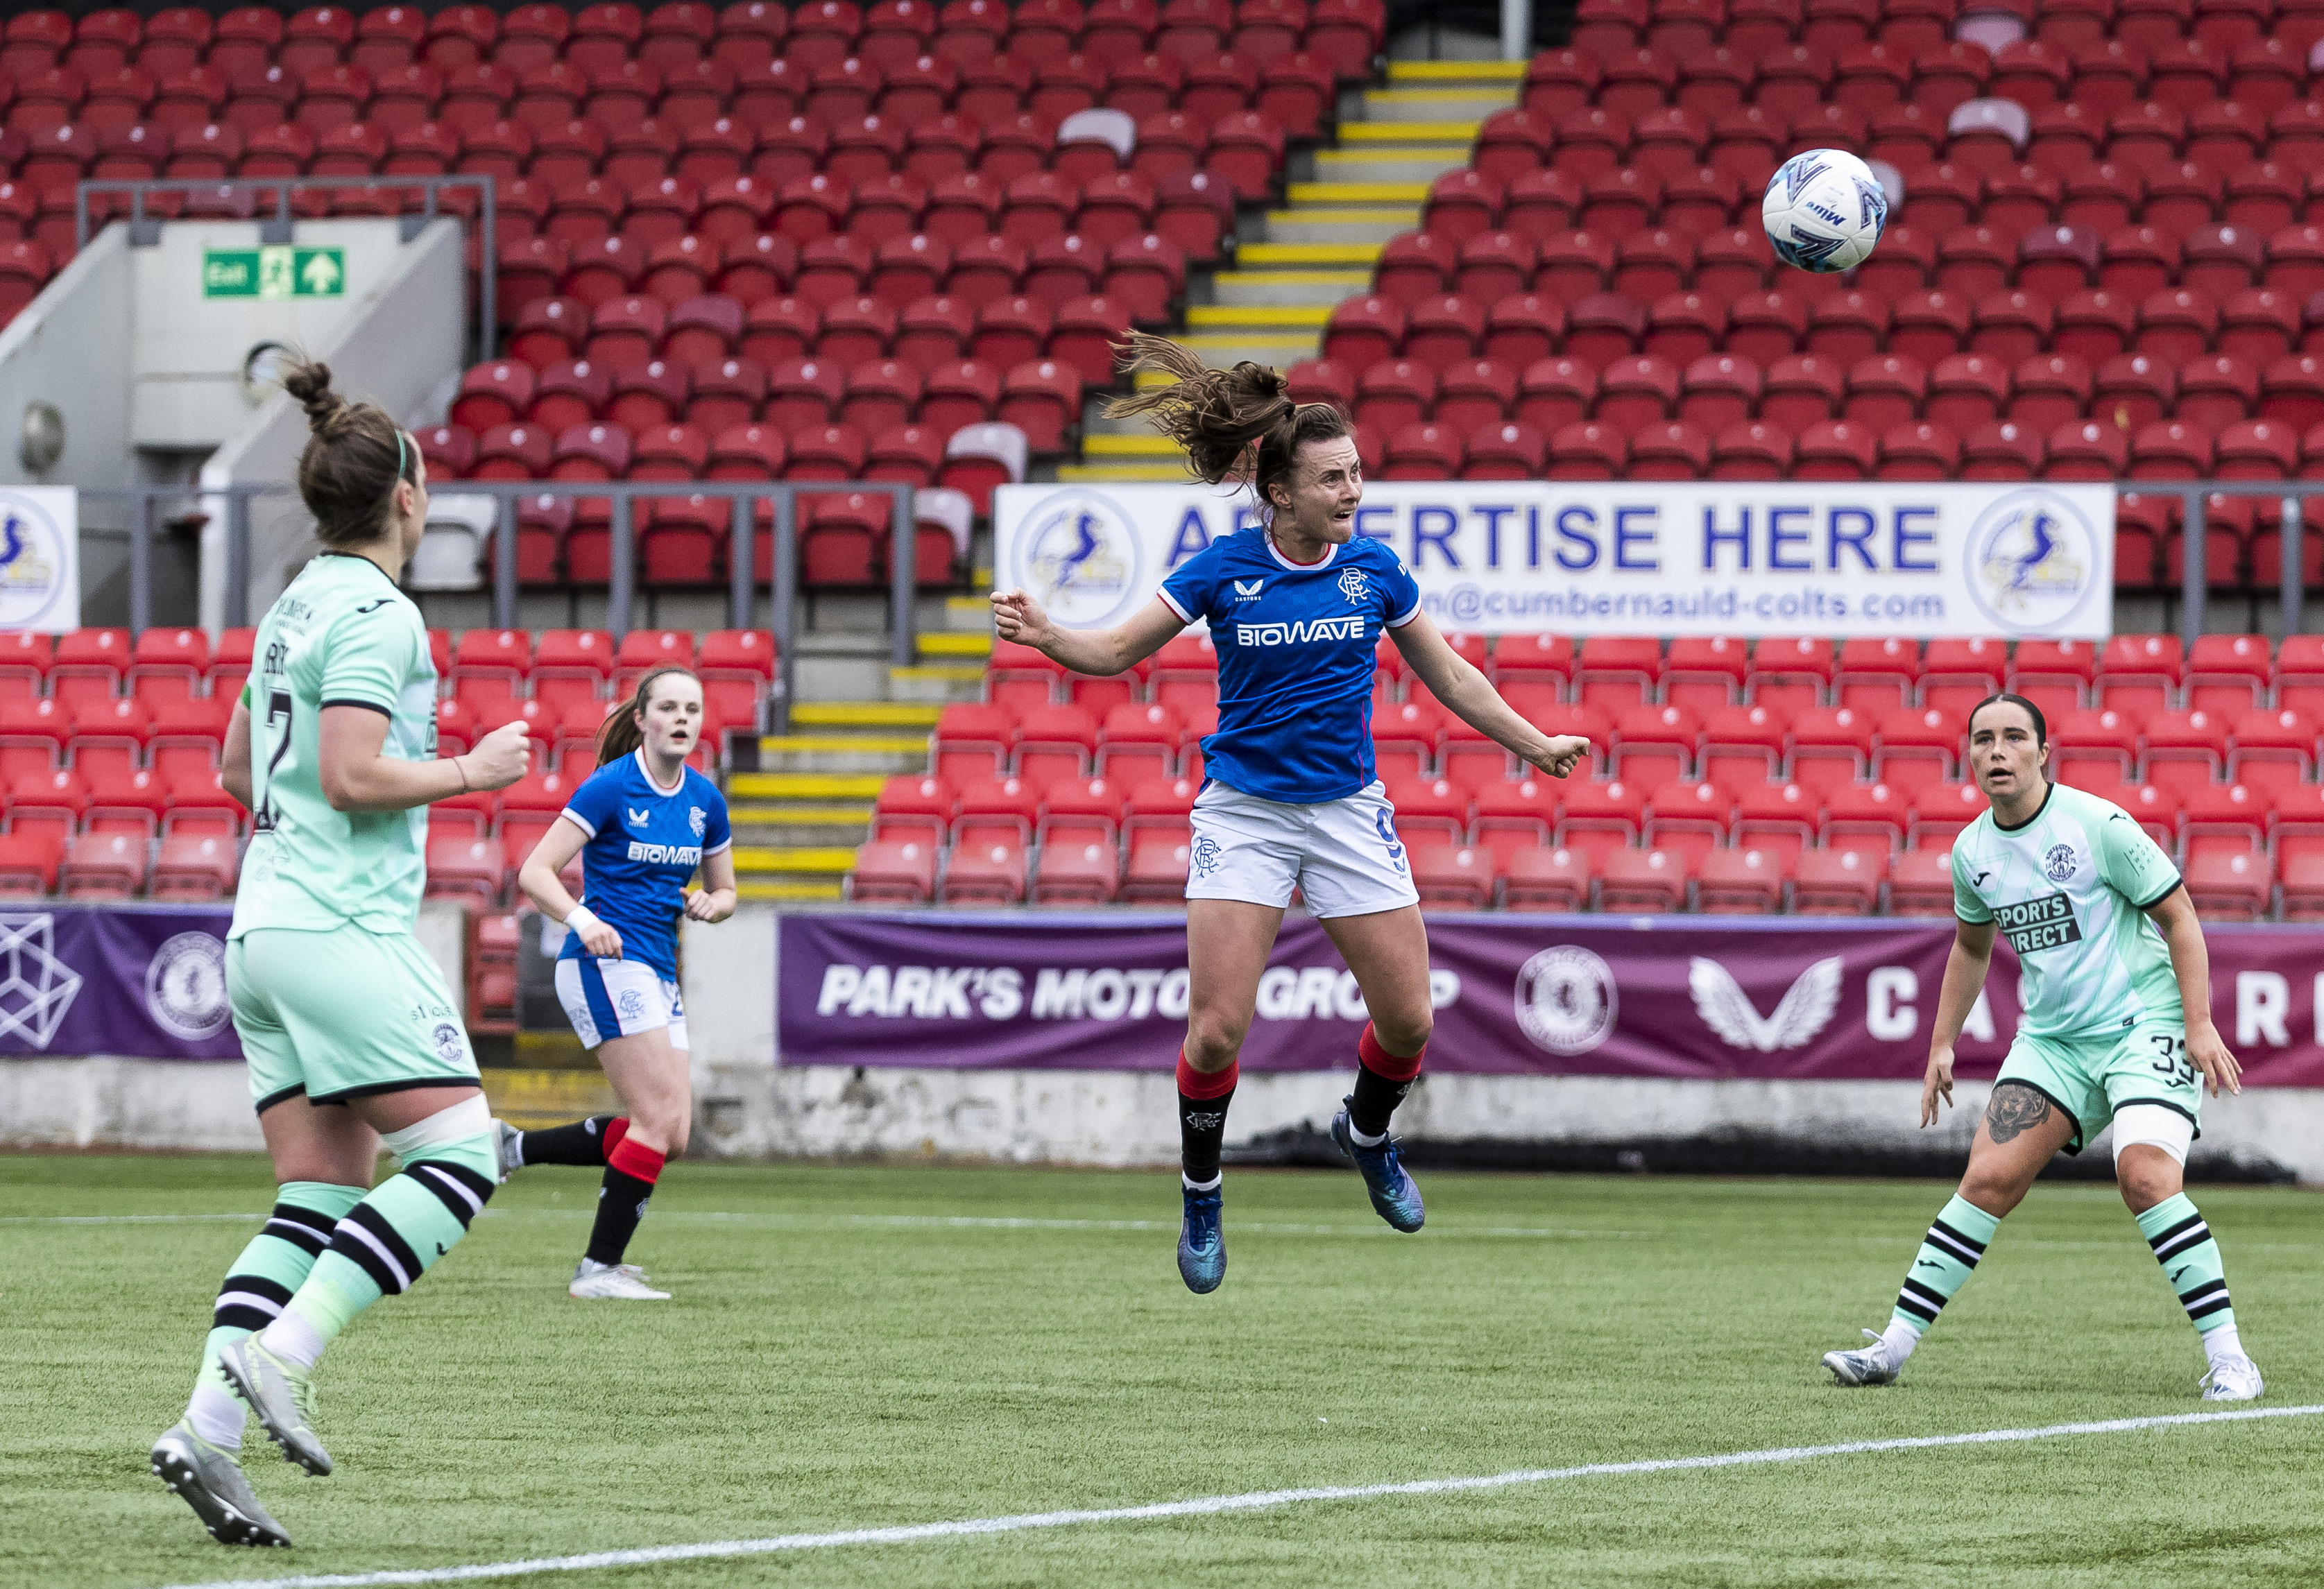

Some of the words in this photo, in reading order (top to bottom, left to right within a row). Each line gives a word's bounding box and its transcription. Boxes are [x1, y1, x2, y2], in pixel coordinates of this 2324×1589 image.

[1167, 505, 1661, 572] AERTISE
[1701, 505, 1938, 572] HERE
[1422, 584, 1945, 623] n@cumbernauld-colts.com
[1237, 616, 1365, 646] BIOWAVE
[1993, 896, 2066, 928] SPORTS
[2008, 922, 2070, 952] IRECT
[817, 965, 1022, 1020] PARK'S
[1031, 966, 1190, 1020] MOTO
[1256, 966, 1461, 1021] GROP
